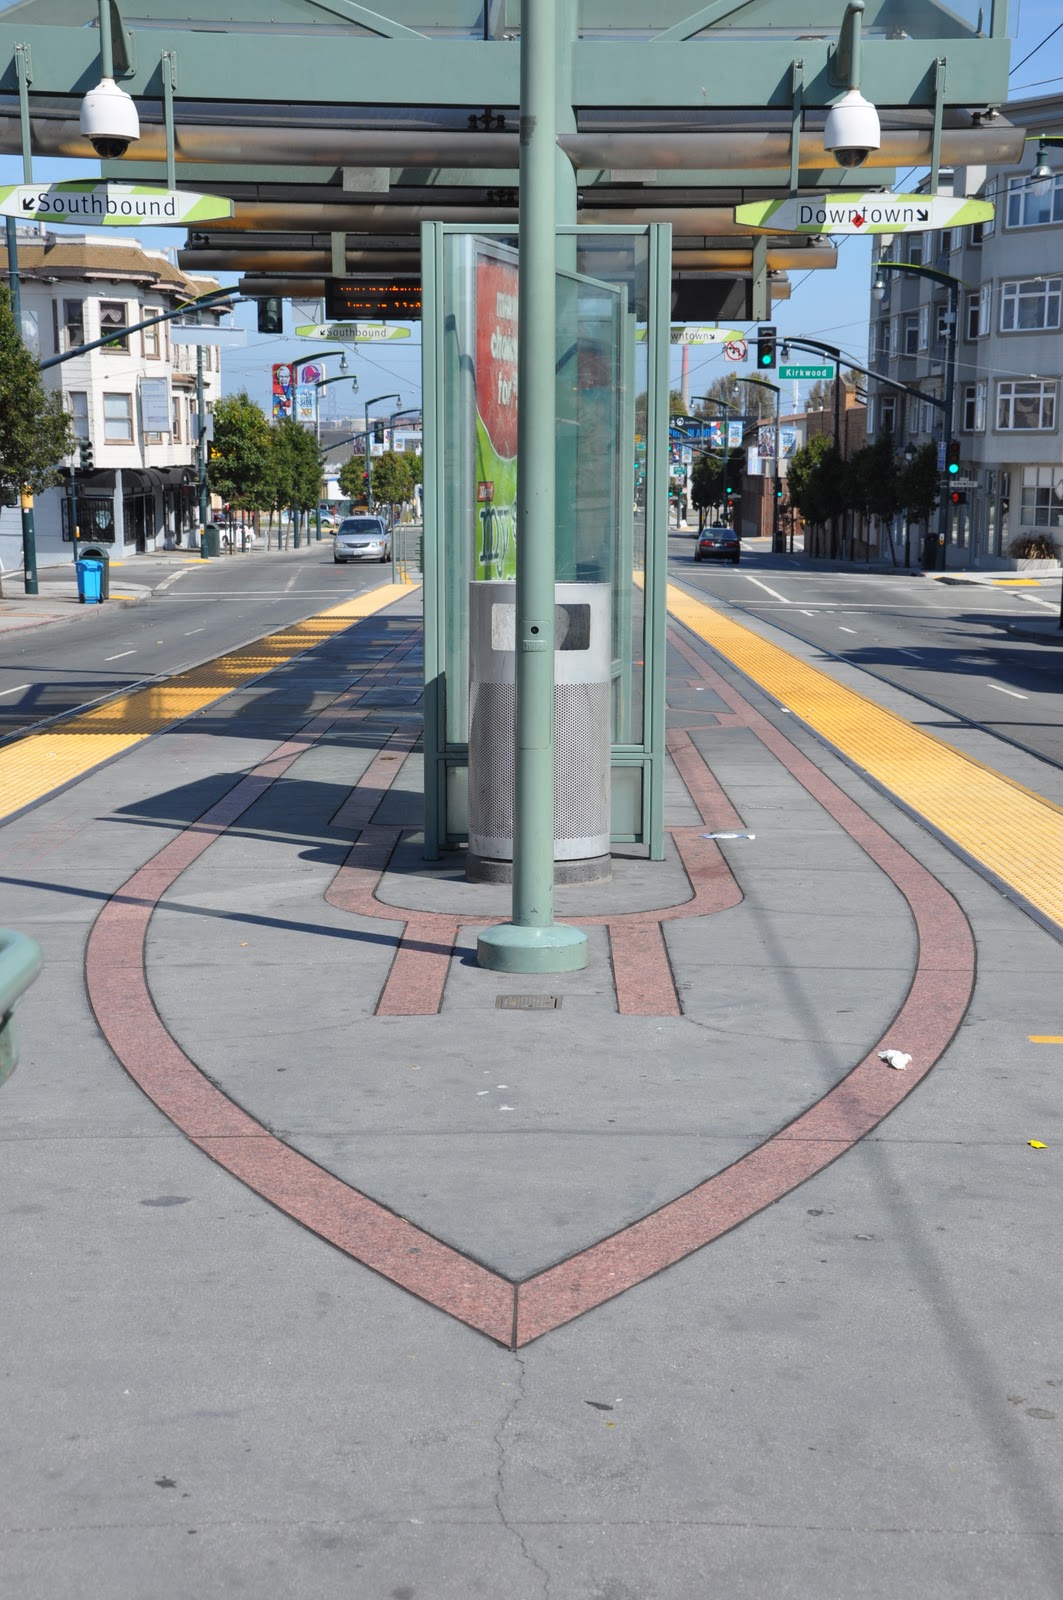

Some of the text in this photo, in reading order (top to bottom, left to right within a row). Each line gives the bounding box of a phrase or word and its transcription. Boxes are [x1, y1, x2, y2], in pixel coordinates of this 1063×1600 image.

[37, 192, 176, 217] Southbound
[800, 205, 914, 224] Downtown
[326, 328, 387, 338] Southbound
[671, 332, 709, 340] wntown
[785, 368, 827, 377] Kirkwood
